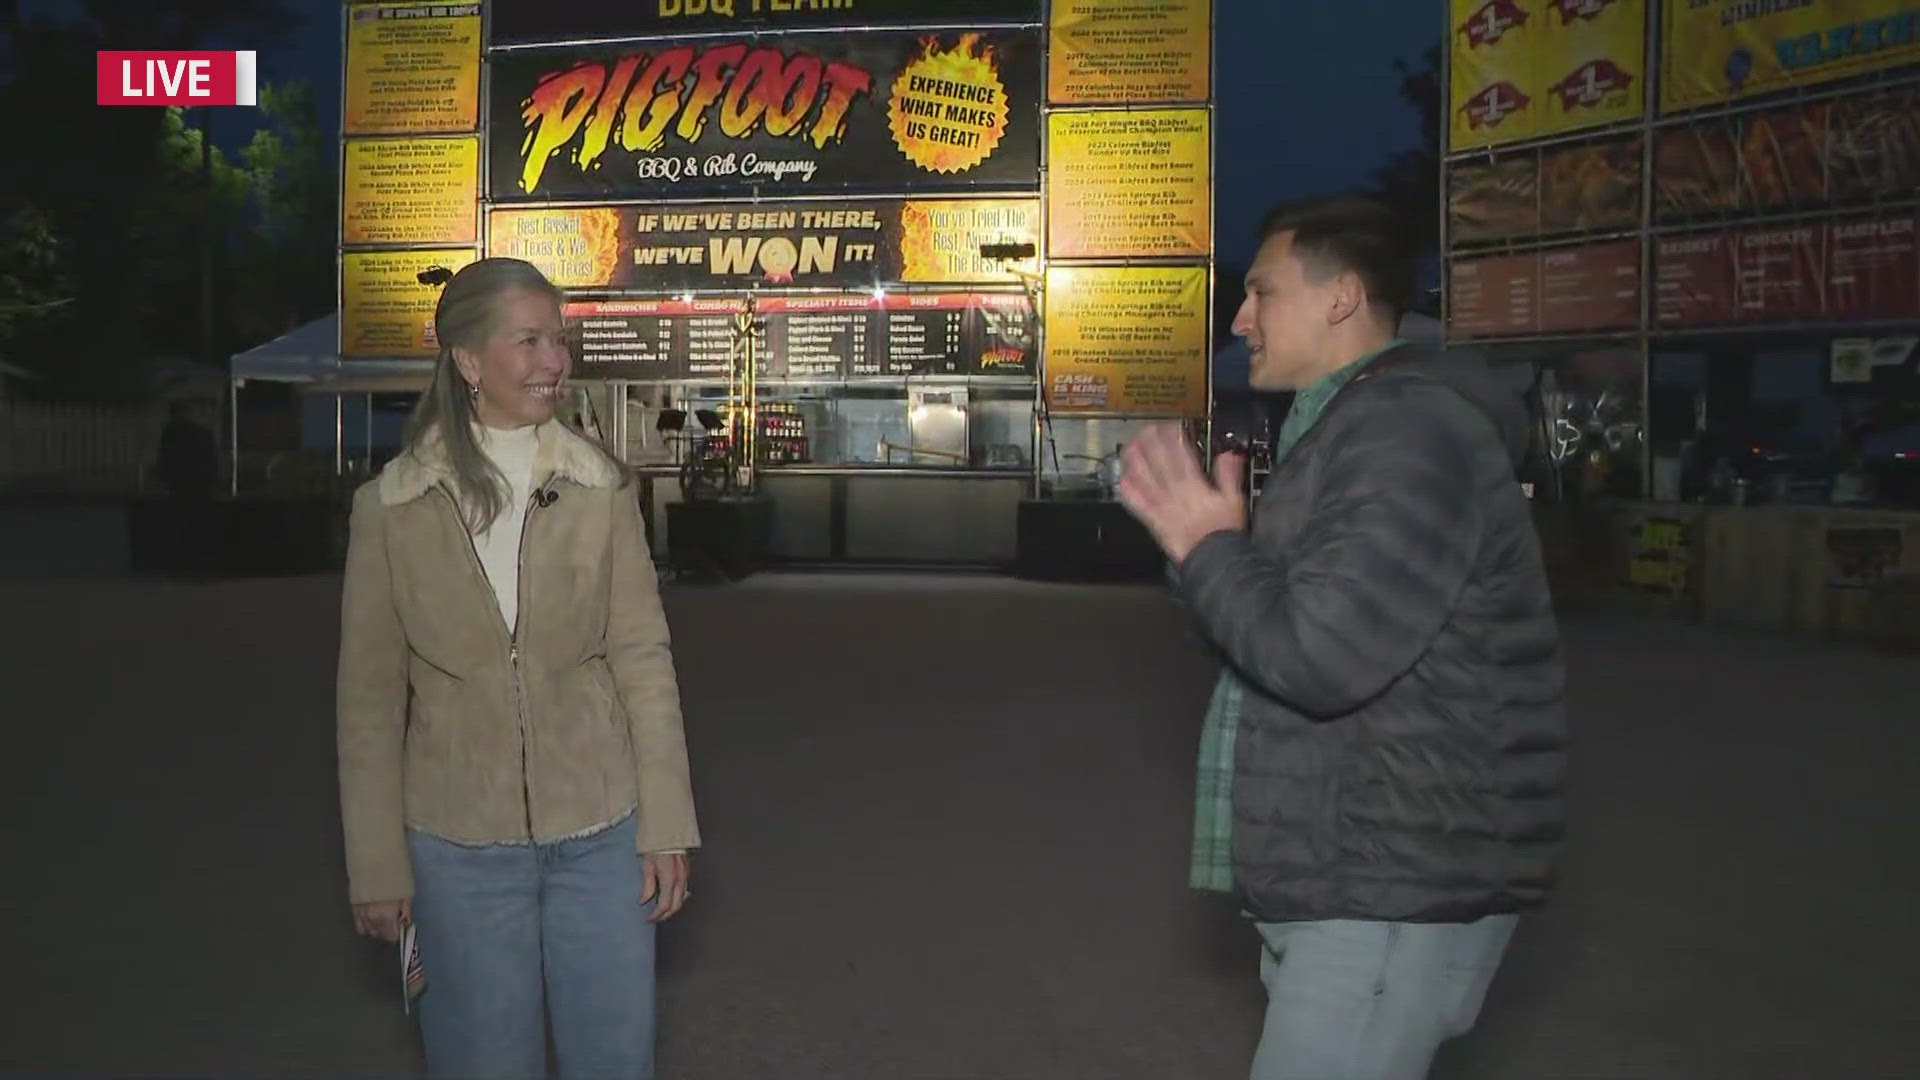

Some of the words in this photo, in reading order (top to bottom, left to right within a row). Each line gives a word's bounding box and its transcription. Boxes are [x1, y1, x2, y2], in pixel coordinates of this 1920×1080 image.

[908, 75, 996, 103] EXPERIENCE
[519, 42, 876, 195] PIGFOOT
[900, 97, 954, 121] WHAT
[956, 104, 996, 129] MAKES
[906, 121, 928, 139] US
[929, 124, 980, 149] GREAT!
[639, 159, 681, 180] BBQ
[684, 159, 698, 177] &
[703, 153, 737, 177] Rib
[740, 152, 816, 182] Company
[638, 215, 658, 233] IF
[663, 213, 733, 232] WE'VE
[736, 211, 796, 231] BEEN
[800, 210, 882, 232] THERE,
[1834, 220, 1913, 240] SAMPLER
[634, 246, 704, 266] WE'VE
[708, 236, 839, 275] WON
[843, 244, 875, 263] IT!
[596, 303, 658, 313] SANDWICHES
[694, 300, 729, 311] COMBO
[785, 298, 839, 309] SPECIALTY
[841, 298, 868, 307] ITEMS
[910, 297, 939, 306] SIDES
[1054, 374, 1093, 384] CASH
[1054, 384, 1069, 393] IS
[1071, 384, 1108, 393] KING
